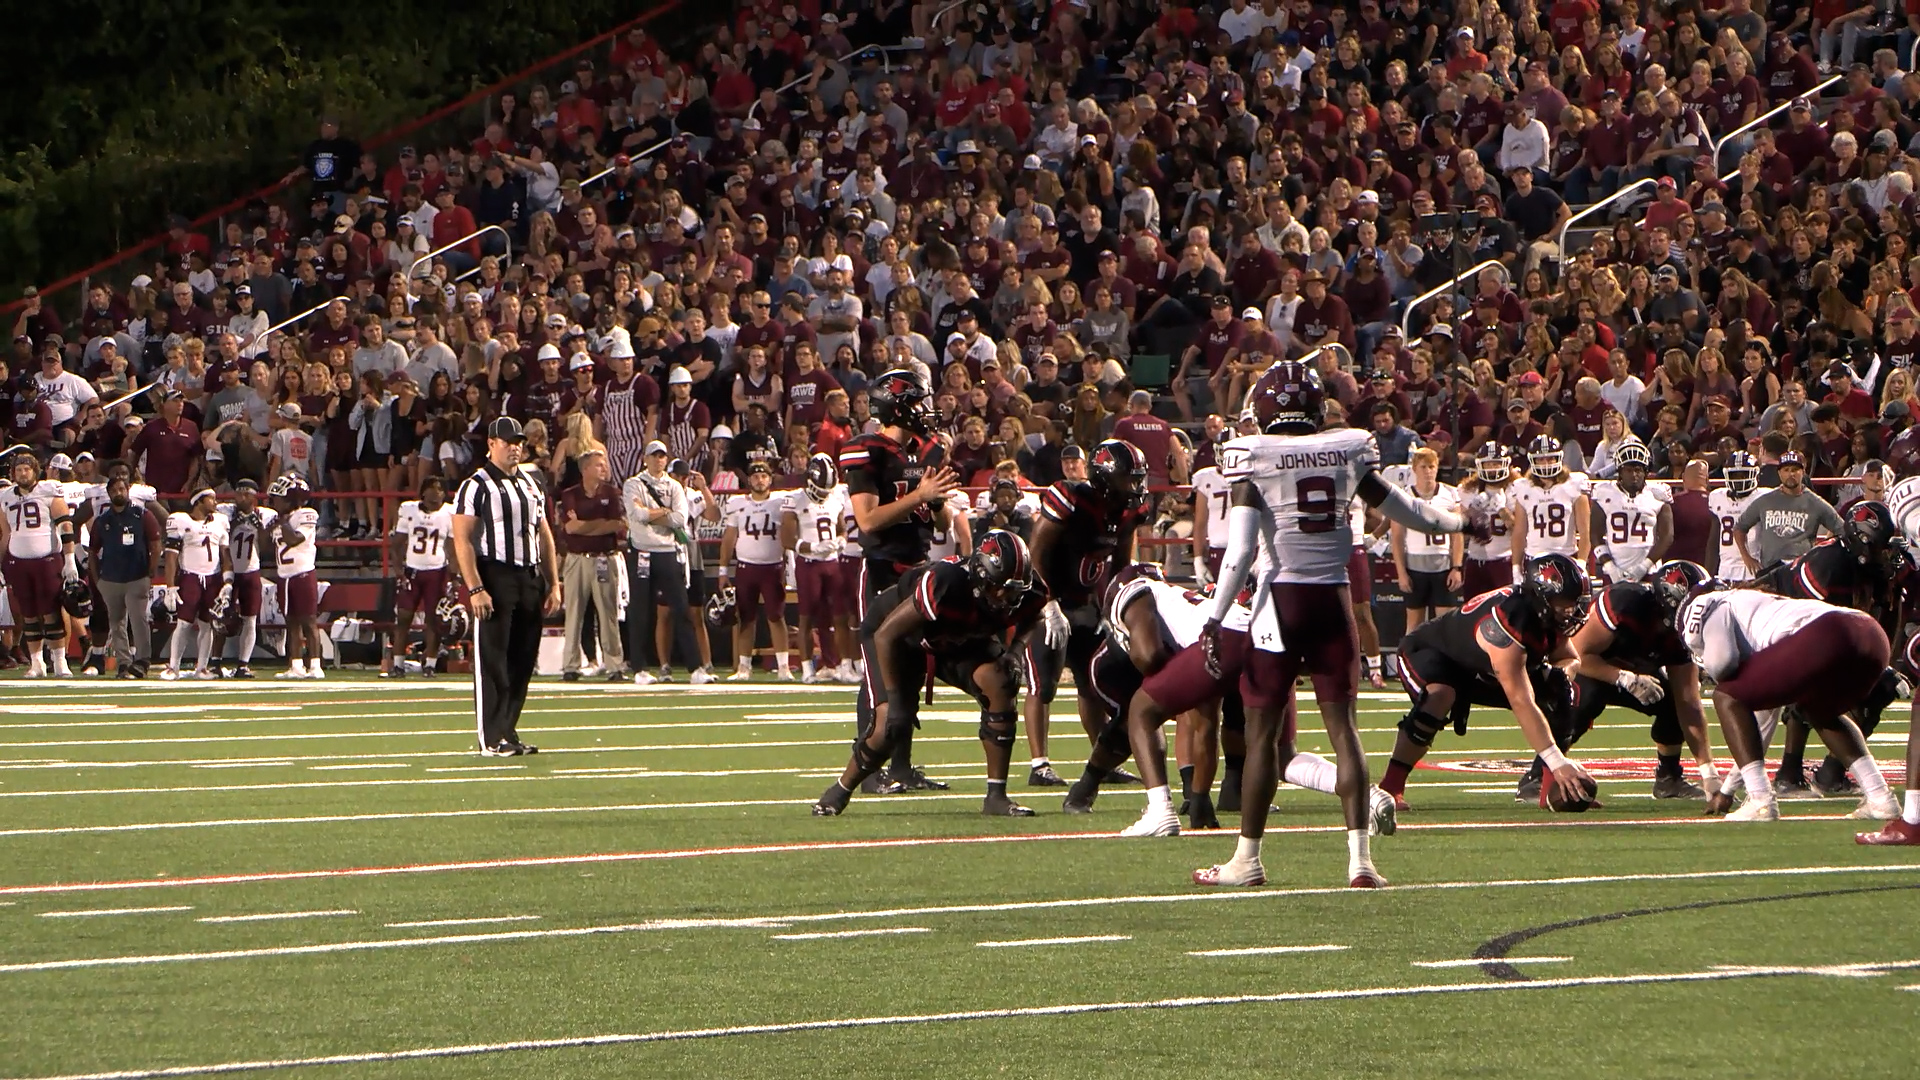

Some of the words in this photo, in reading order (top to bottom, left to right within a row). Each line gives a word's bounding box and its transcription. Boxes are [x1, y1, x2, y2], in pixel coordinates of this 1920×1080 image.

[1134, 422, 1163, 431] SALUKIS
[1276, 450, 1348, 470] JOHNSON
[1780, 454, 1798, 464] SIU
[903, 468, 923, 477] SEMO
[9, 501, 42, 532] 79
[1296, 475, 1337, 534] 9
[745, 514, 777, 540] 44
[1532, 504, 1565, 538] 48
[1610, 512, 1648, 544] 94
[1765, 514, 1807, 531] FOOTBALL
[201, 536, 213, 562] 1
[234, 532, 253, 560] 11
[413, 527, 440, 556] 31
